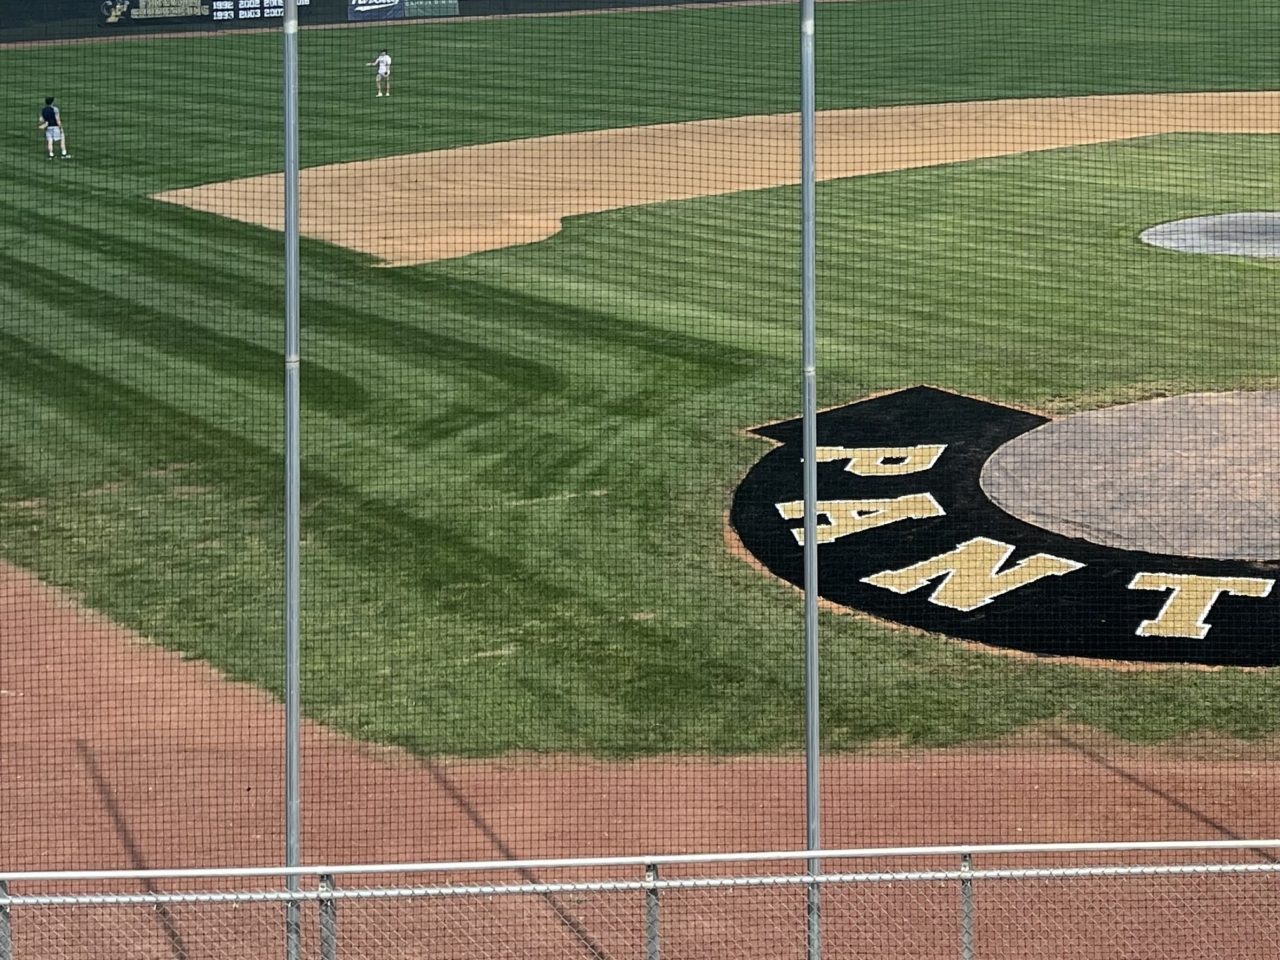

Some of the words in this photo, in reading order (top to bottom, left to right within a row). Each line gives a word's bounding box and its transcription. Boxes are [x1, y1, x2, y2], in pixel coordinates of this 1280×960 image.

[212, 0, 234, 10] 1992
[238, 0, 261, 9] 2002
[213, 10, 235, 20] 1993
[238, 9, 261, 19] 2003
